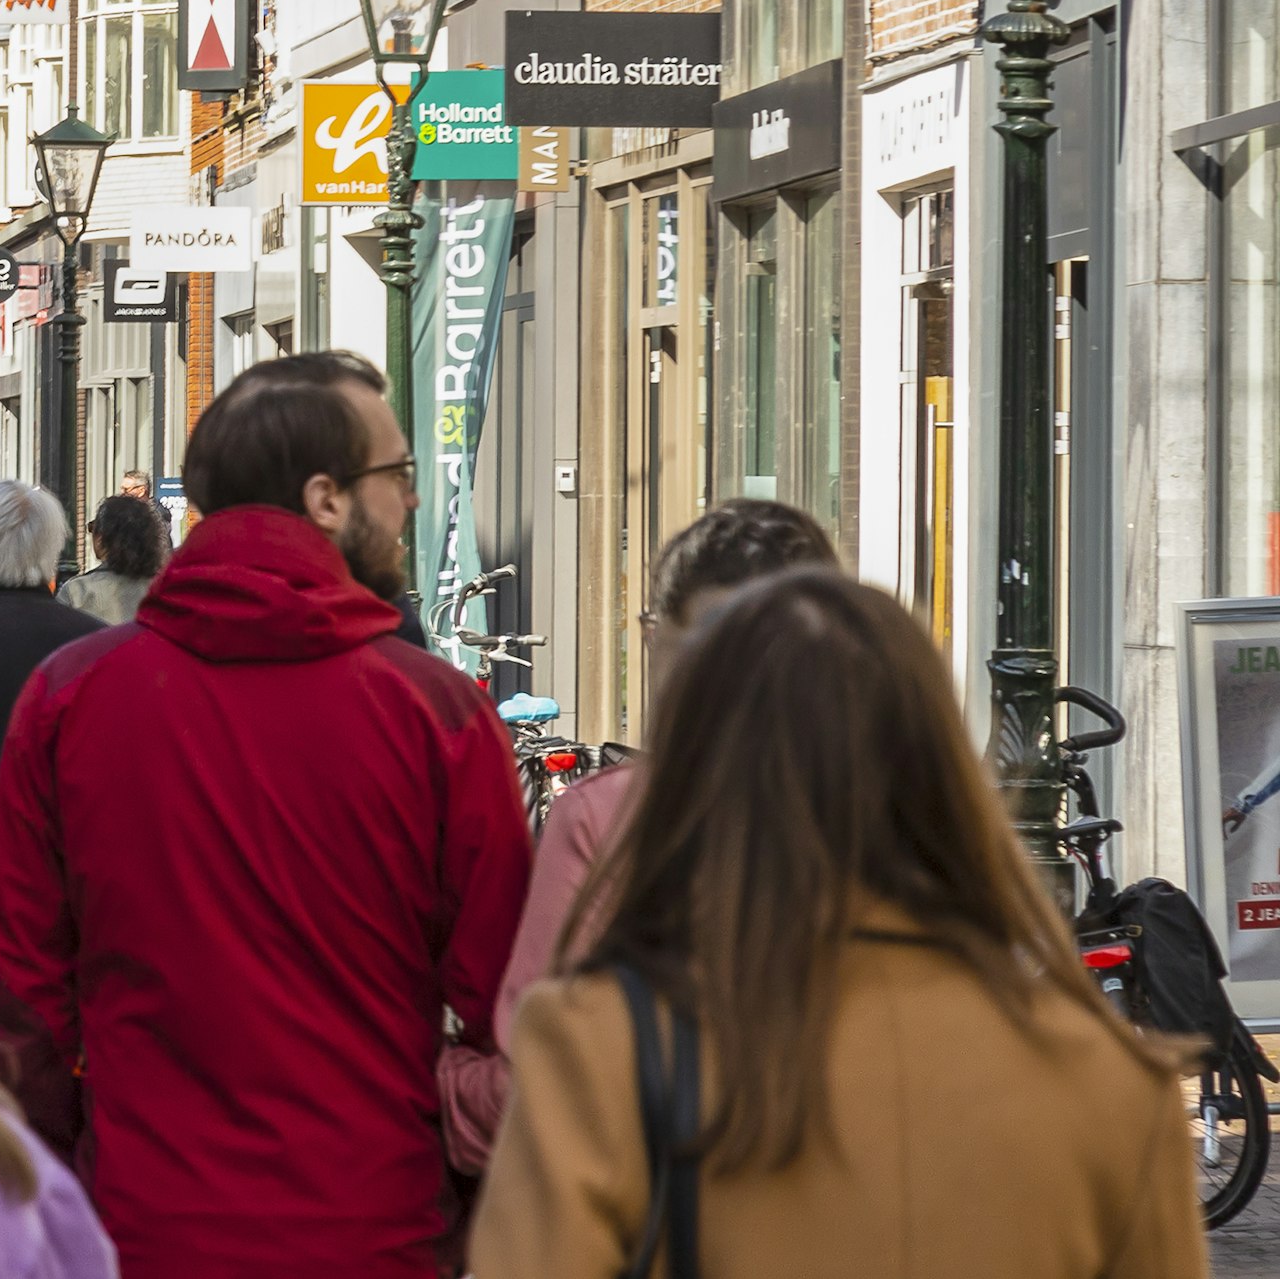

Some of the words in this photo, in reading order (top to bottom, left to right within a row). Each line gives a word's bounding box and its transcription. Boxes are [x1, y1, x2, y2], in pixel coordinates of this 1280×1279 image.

[513, 52, 621, 86] claudia
[623, 56, 722, 86] sträter
[418, 102, 503, 123] Holland
[314, 179, 391, 195] vanHar
